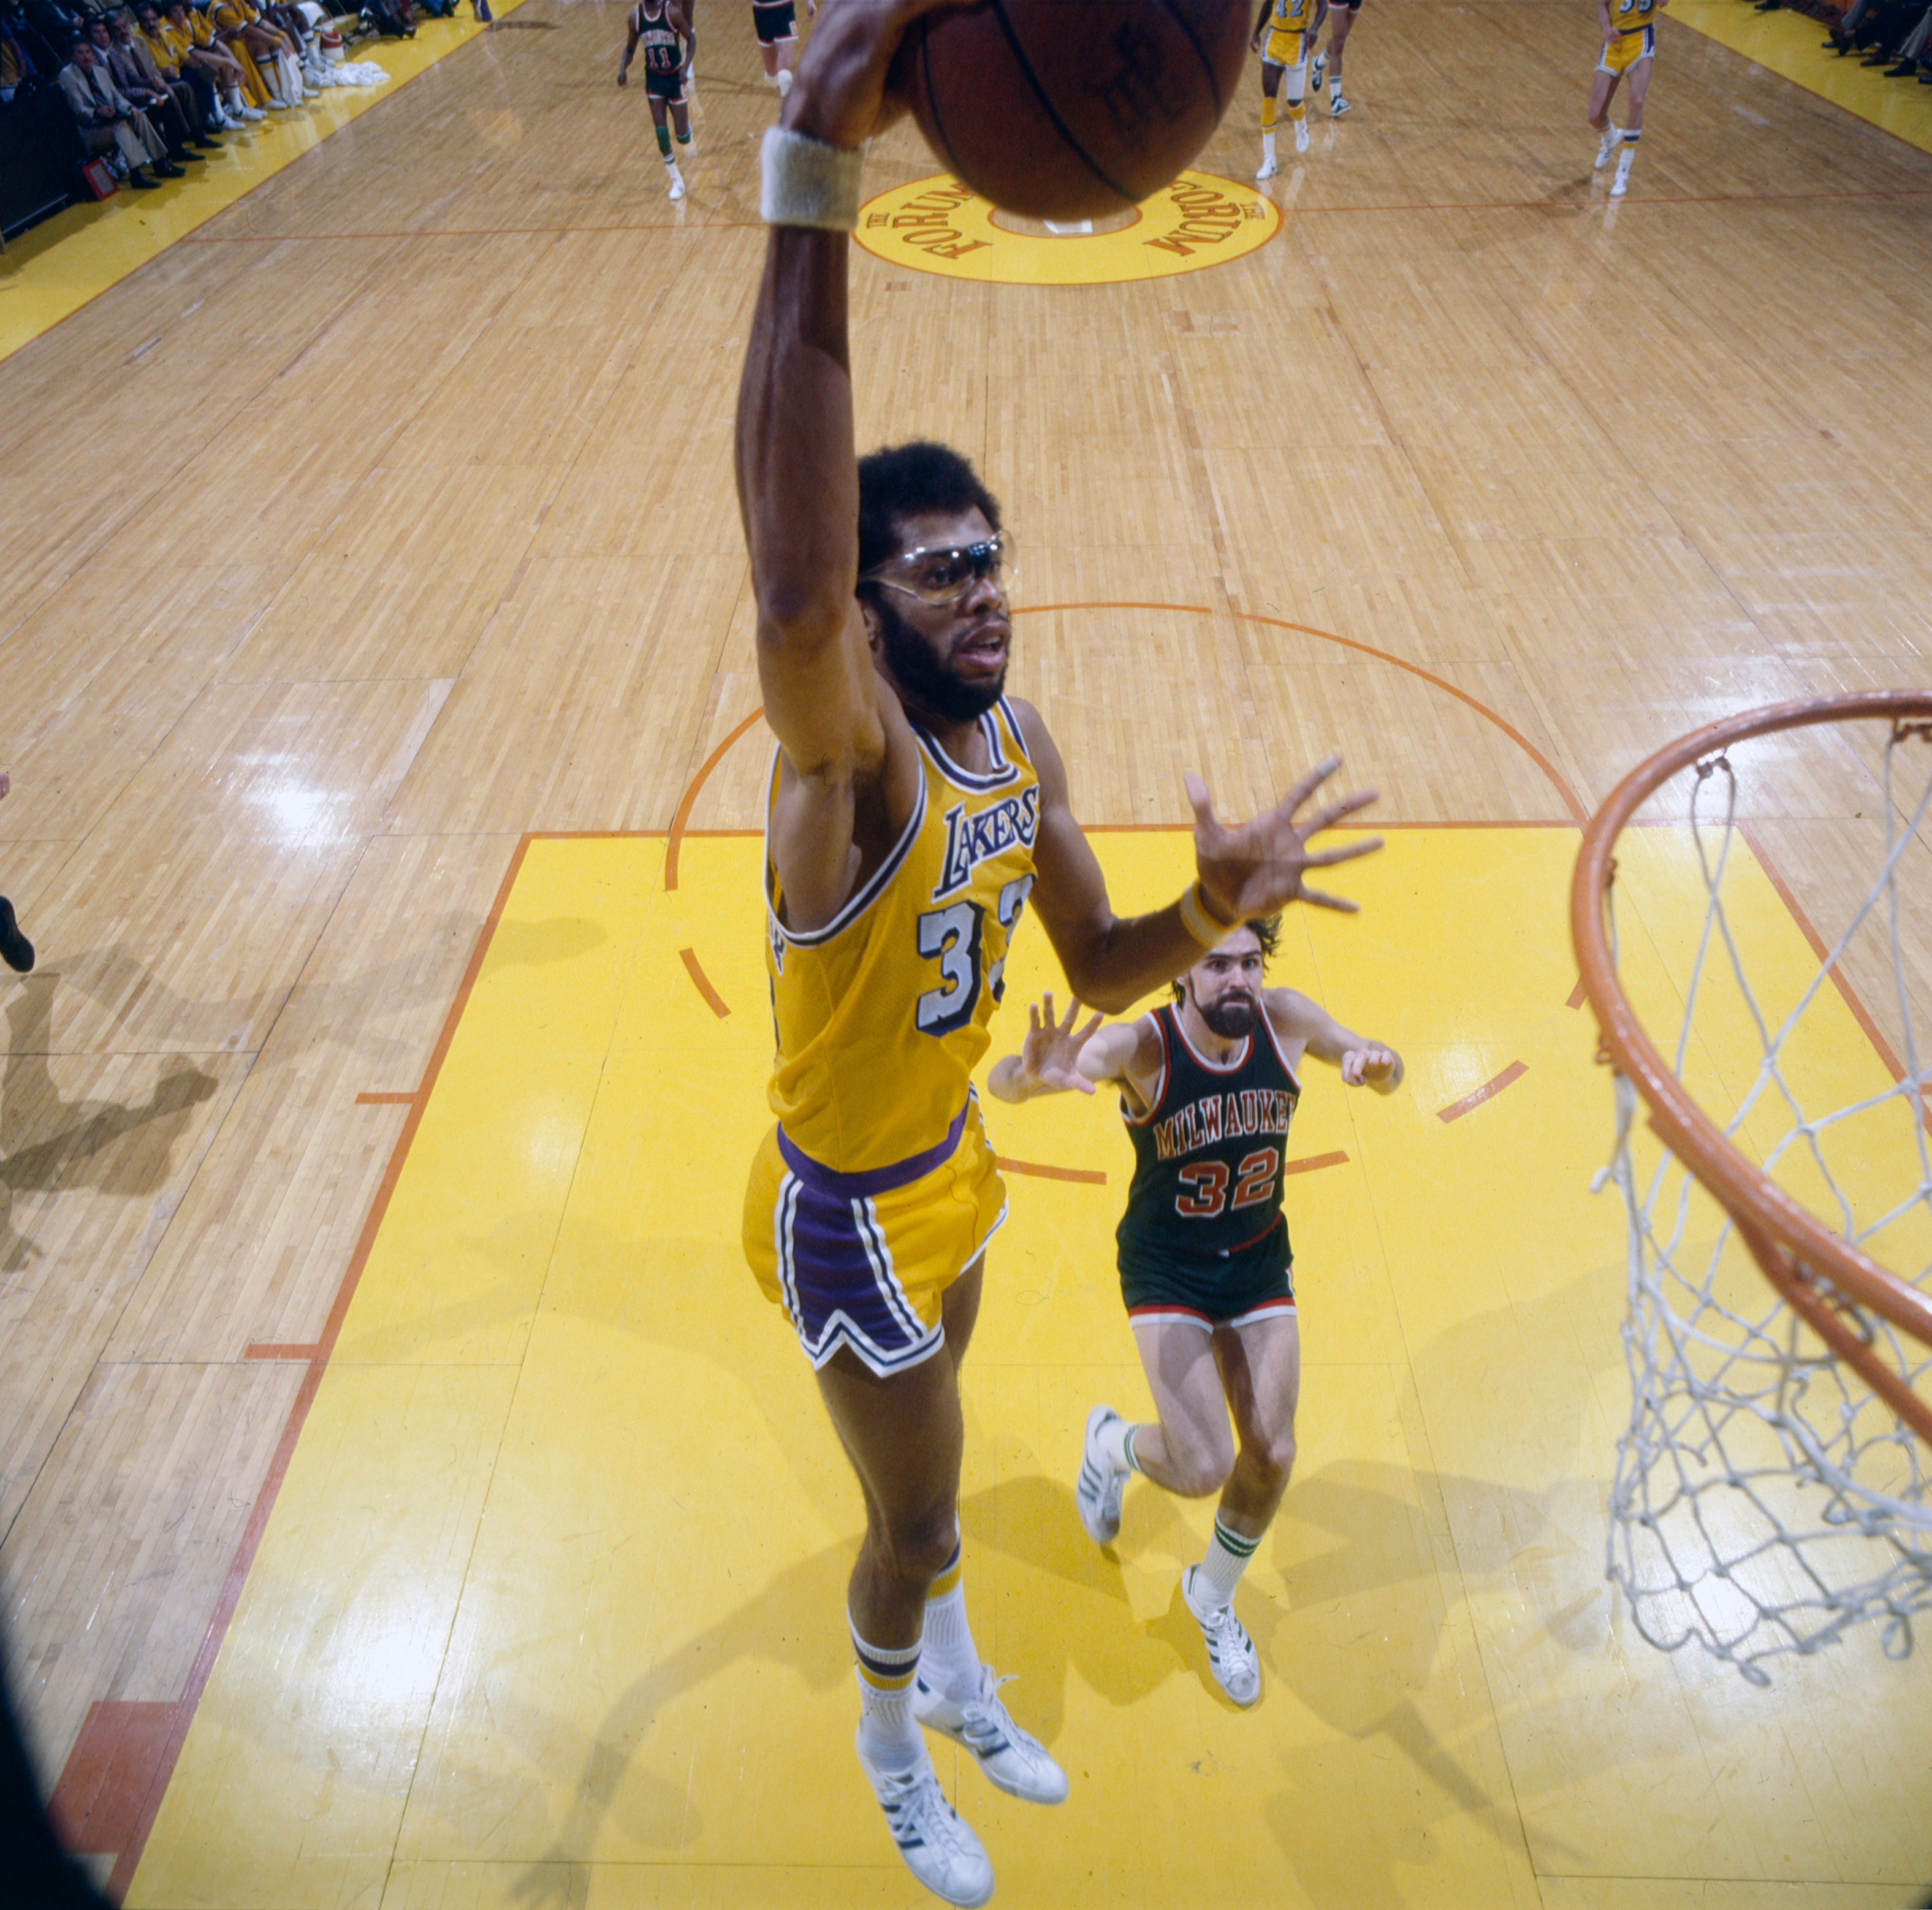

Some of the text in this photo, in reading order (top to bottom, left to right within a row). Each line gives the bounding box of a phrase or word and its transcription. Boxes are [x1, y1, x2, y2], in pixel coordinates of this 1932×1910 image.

[648, 47, 671, 69] 11
[932, 784, 1040, 904] LAKERS
[1175, 1146, 1279, 1218] 32
